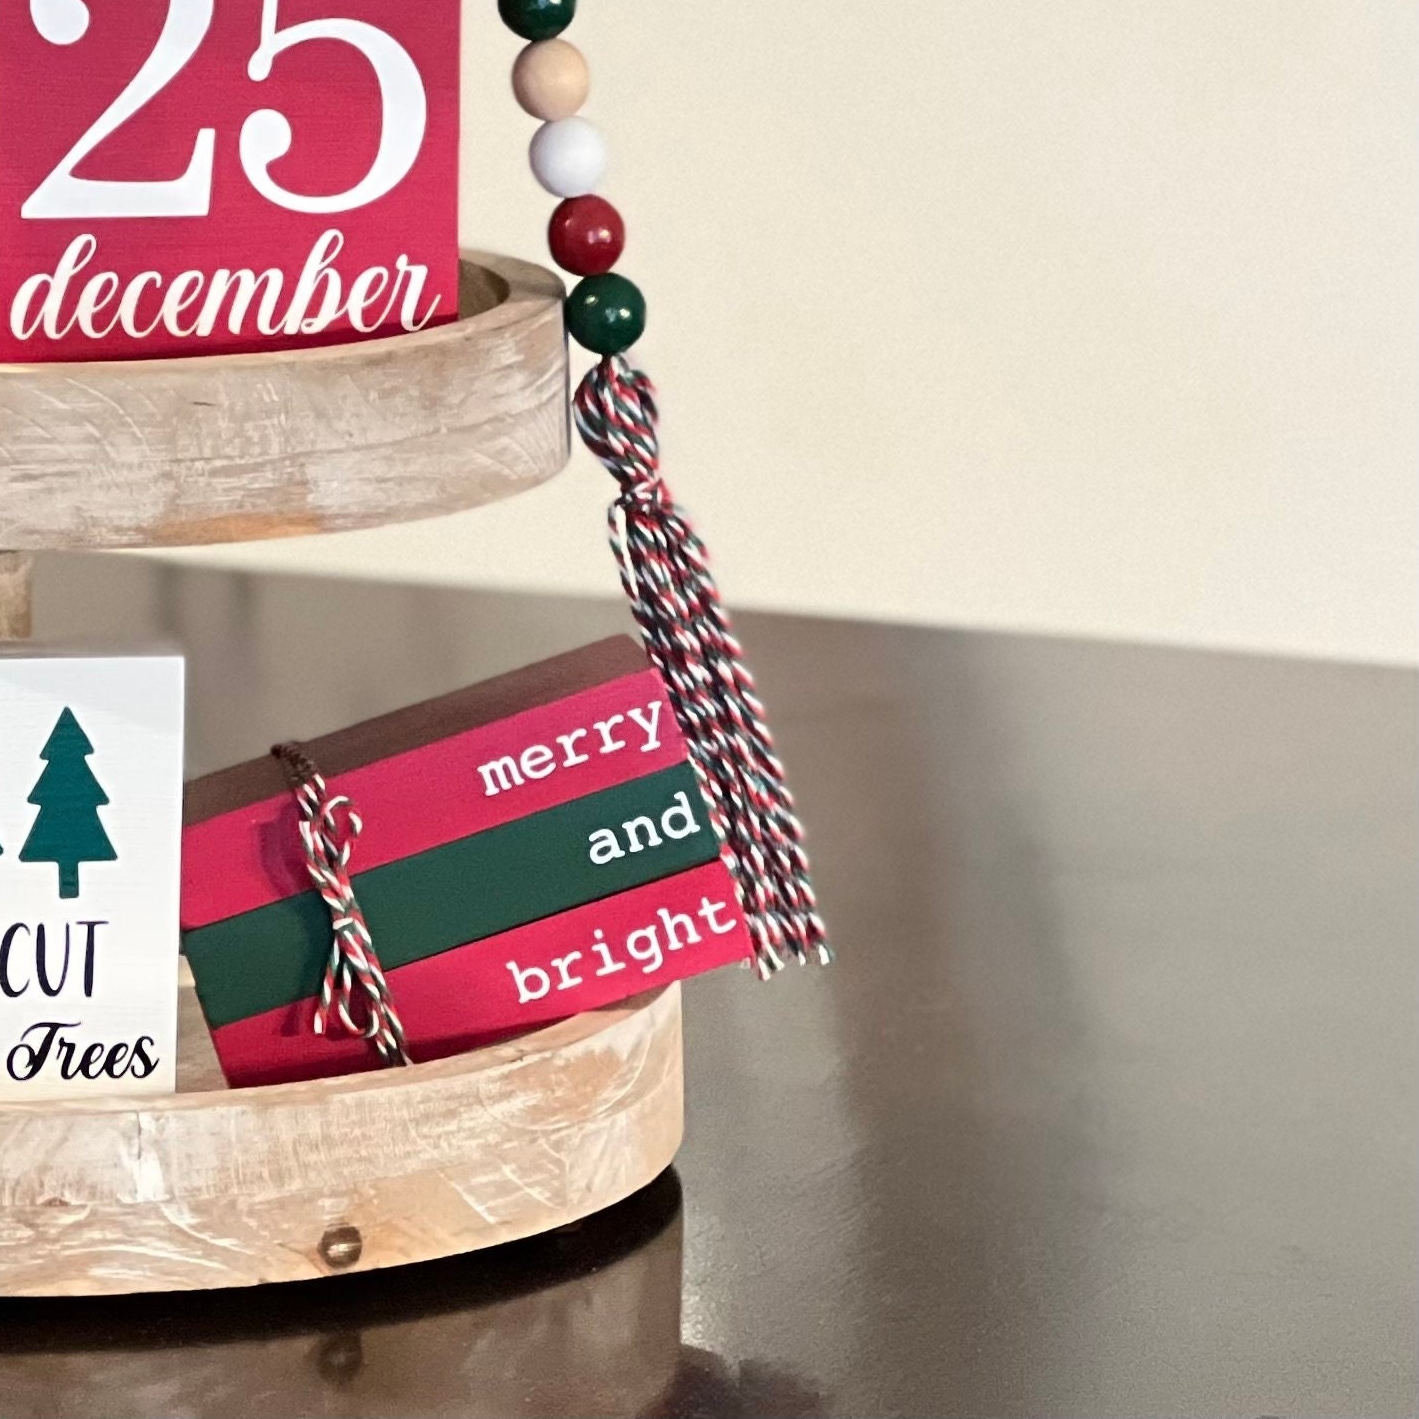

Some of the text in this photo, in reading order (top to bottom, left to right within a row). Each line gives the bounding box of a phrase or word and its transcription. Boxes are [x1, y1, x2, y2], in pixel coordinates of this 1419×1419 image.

[9, 228, 442, 340] december
[477, 700, 663, 796] merry
[588, 791, 701, 864] and
[505, 897, 737, 1003] bright
[5, 1020, 161, 1082] Trees
